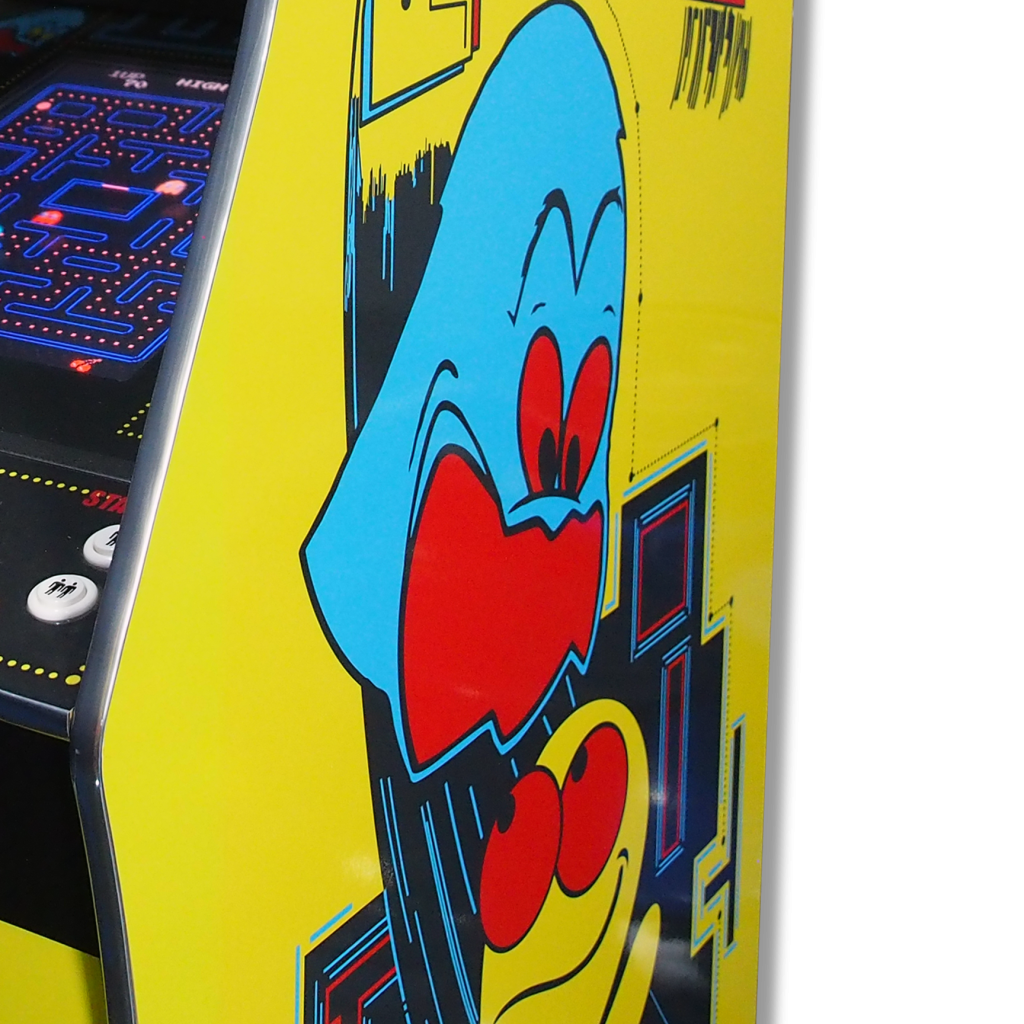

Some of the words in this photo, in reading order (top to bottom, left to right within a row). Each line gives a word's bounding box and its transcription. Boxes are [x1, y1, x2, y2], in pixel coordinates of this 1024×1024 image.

[109, 70, 146, 79] 1UP
[176, 78, 229, 92] HIGH
[82, 489, 128, 514] STA
